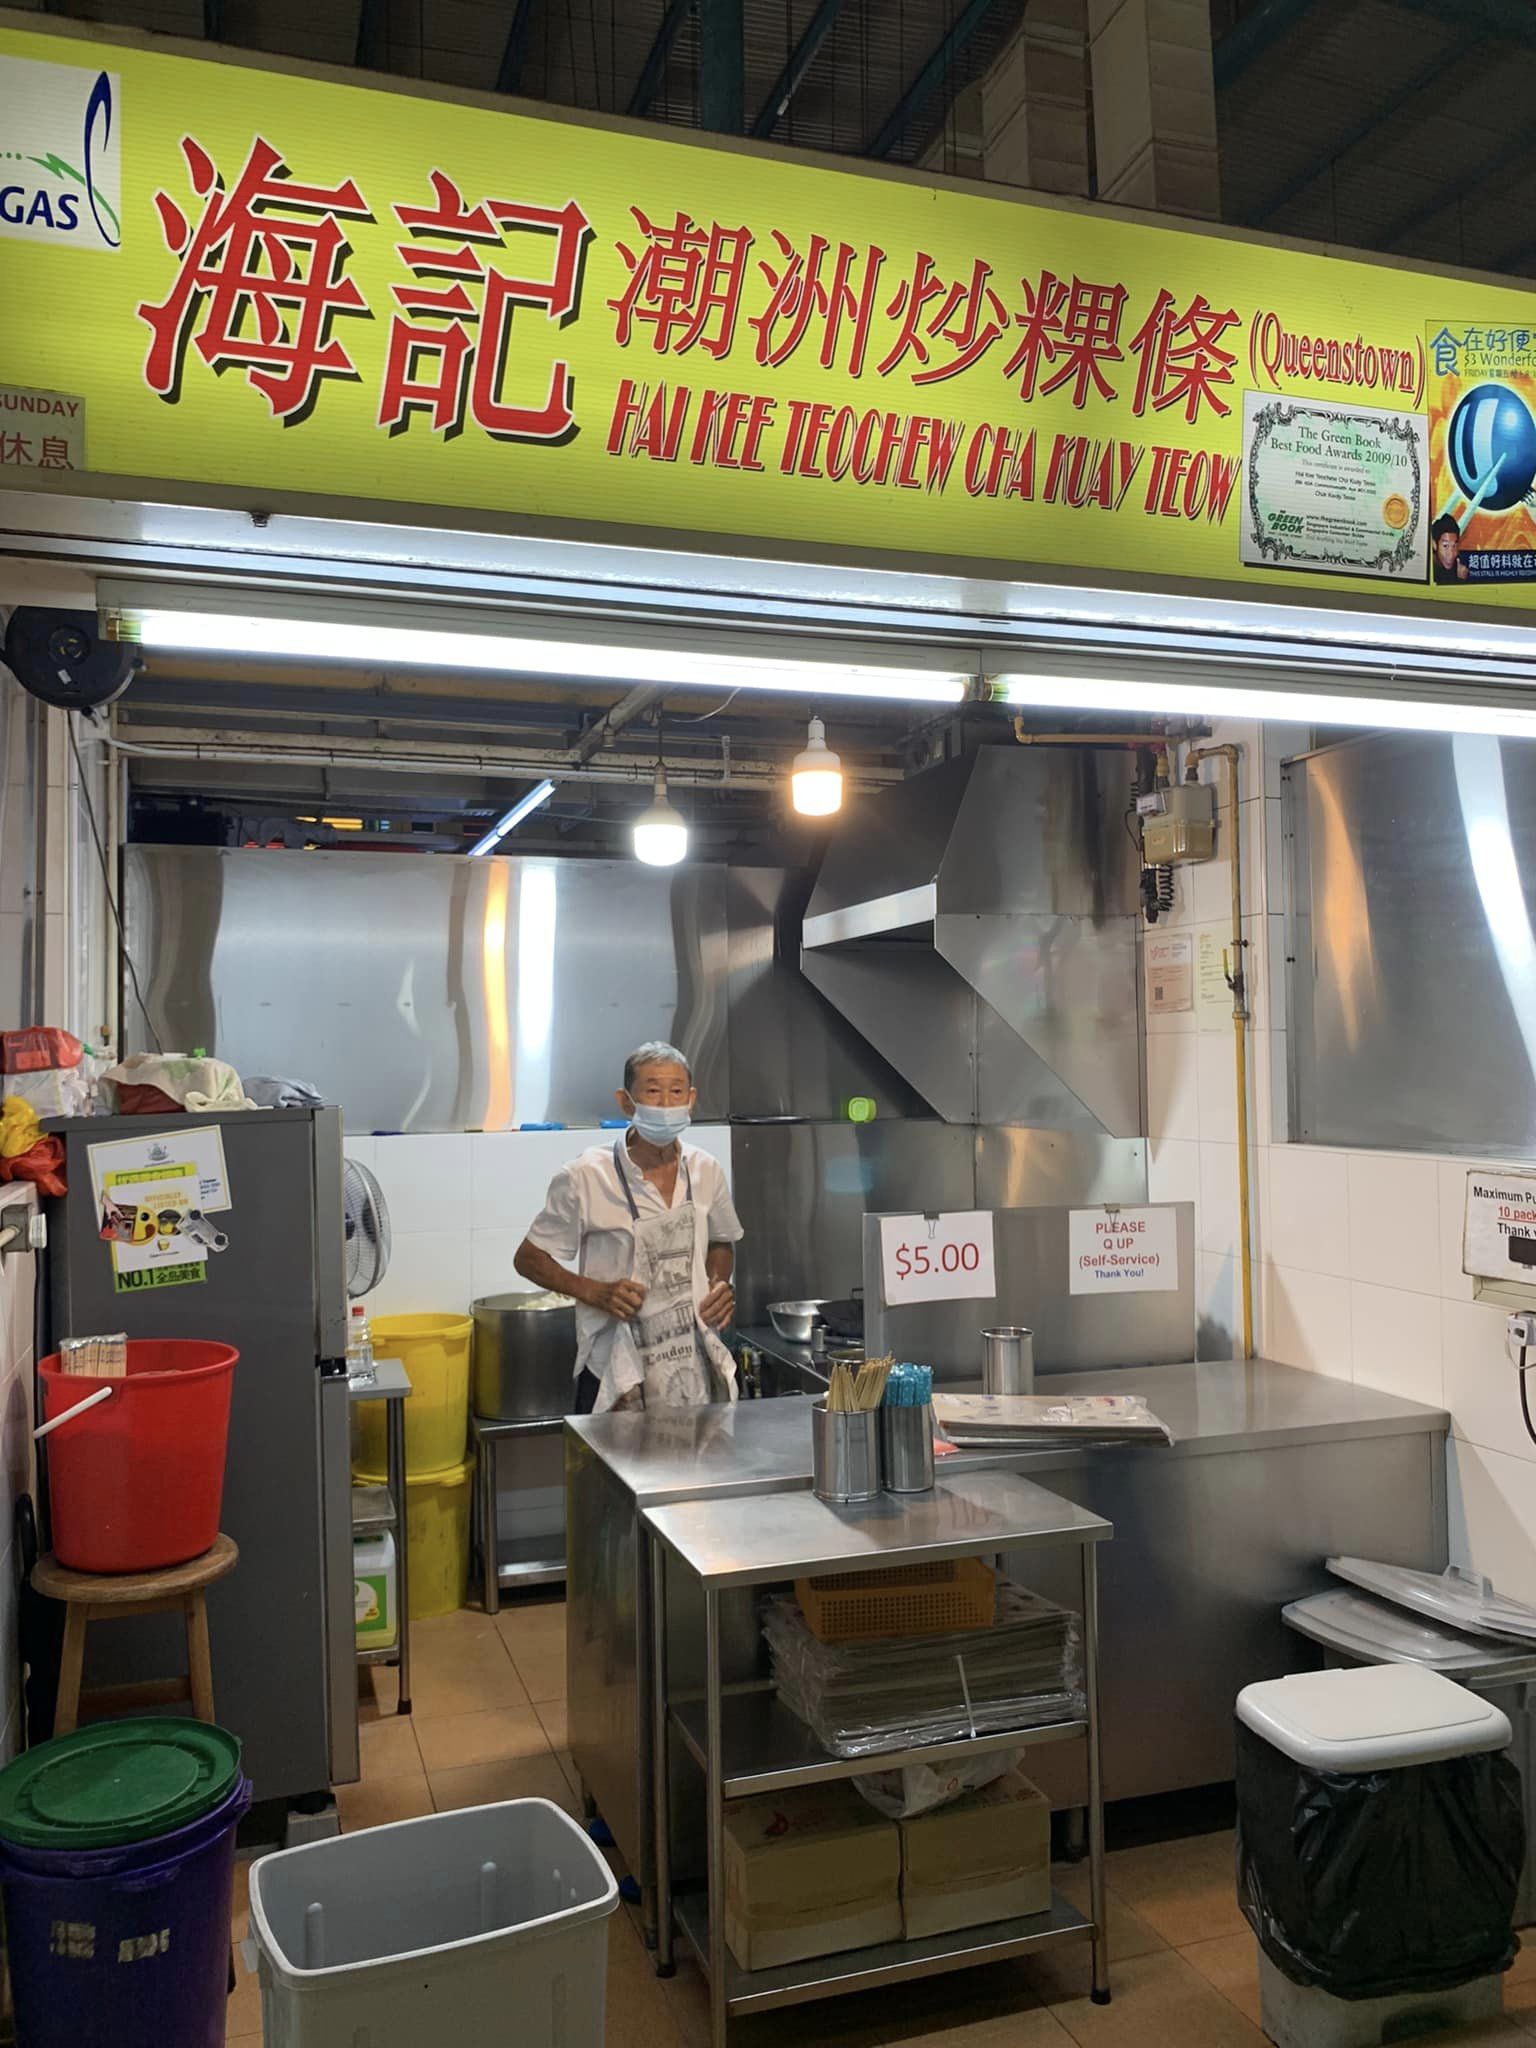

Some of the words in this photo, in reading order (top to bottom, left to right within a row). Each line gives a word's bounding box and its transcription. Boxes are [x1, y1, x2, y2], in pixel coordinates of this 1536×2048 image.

[0, 186, 79, 230] GAS
[136, 134, 596, 446] 海記
[1249, 309, 1425, 410] (Queenstown)
[0, 394, 79, 417] UNDAY
[1298, 426, 1318, 440] The
[1321, 429, 1352, 445] Green
[1356, 434, 1381, 449] Book
[0, 431, 74, 470] 休息
[606, 379, 691, 460] HAI
[690, 389, 777, 472] KEE
[780, 400, 965, 496] TEOCHEW
[964, 422, 1036, 502] CHA
[1042, 433, 1145, 511] KUAY
[1144, 446, 1242, 526] TEOW
[1271, 437, 1292, 451] Best
[1296, 441, 1321, 455] Food
[1325, 445, 1362, 461] Awards
[1366, 450, 1407, 467] 2009/10
[1267, 513, 1304, 525] GREEN
[1271, 522, 1304, 534] BOOK
[1473, 1186, 1523, 1202] Maximum
[1498, 1206, 1510, 1217] 10
[1096, 1221, 1146, 1234] PLEASE
[1497, 1222, 1531, 1238] Thank
[1103, 1238, 1113, 1250] Q
[1116, 1238, 1134, 1249] UP
[895, 1242, 980, 1280] $5.00
[1079, 1253, 1160, 1270] (Self-Service)
[1094, 1269, 1121, 1279] Thank
[1124, 1268, 1144, 1278] You!
